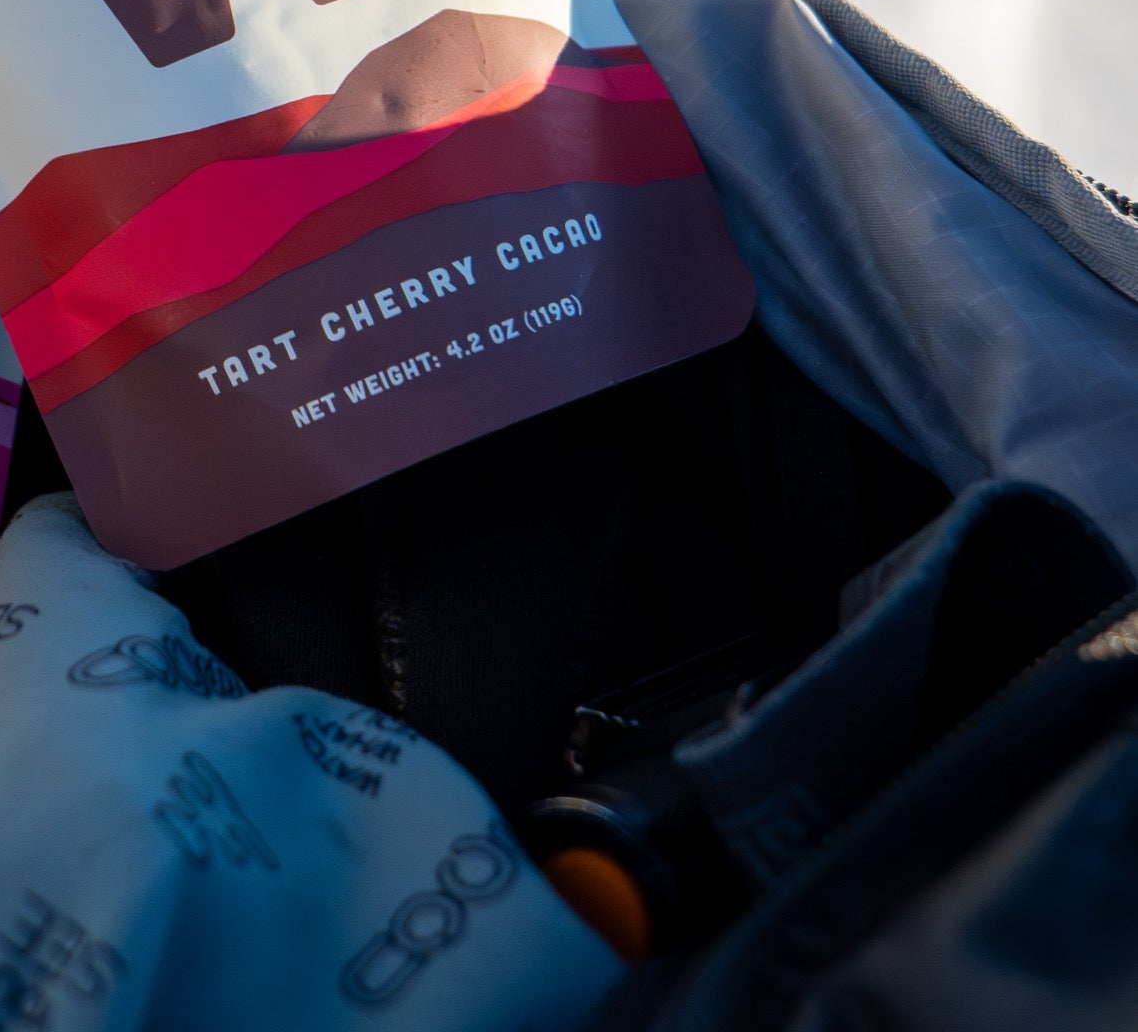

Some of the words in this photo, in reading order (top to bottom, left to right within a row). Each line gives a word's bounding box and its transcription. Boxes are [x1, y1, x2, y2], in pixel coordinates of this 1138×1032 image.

[198, 330, 297, 396] TART
[320, 256, 477, 342] CHERRY
[496, 213, 603, 271] CACAO
[291, 392, 337, 428] NET
[343, 351, 442, 405] WEIGHT:
[446, 332, 485, 361] 4.2
[490, 318, 520, 345] OZ
[523, 294, 583, 333] (119G)
